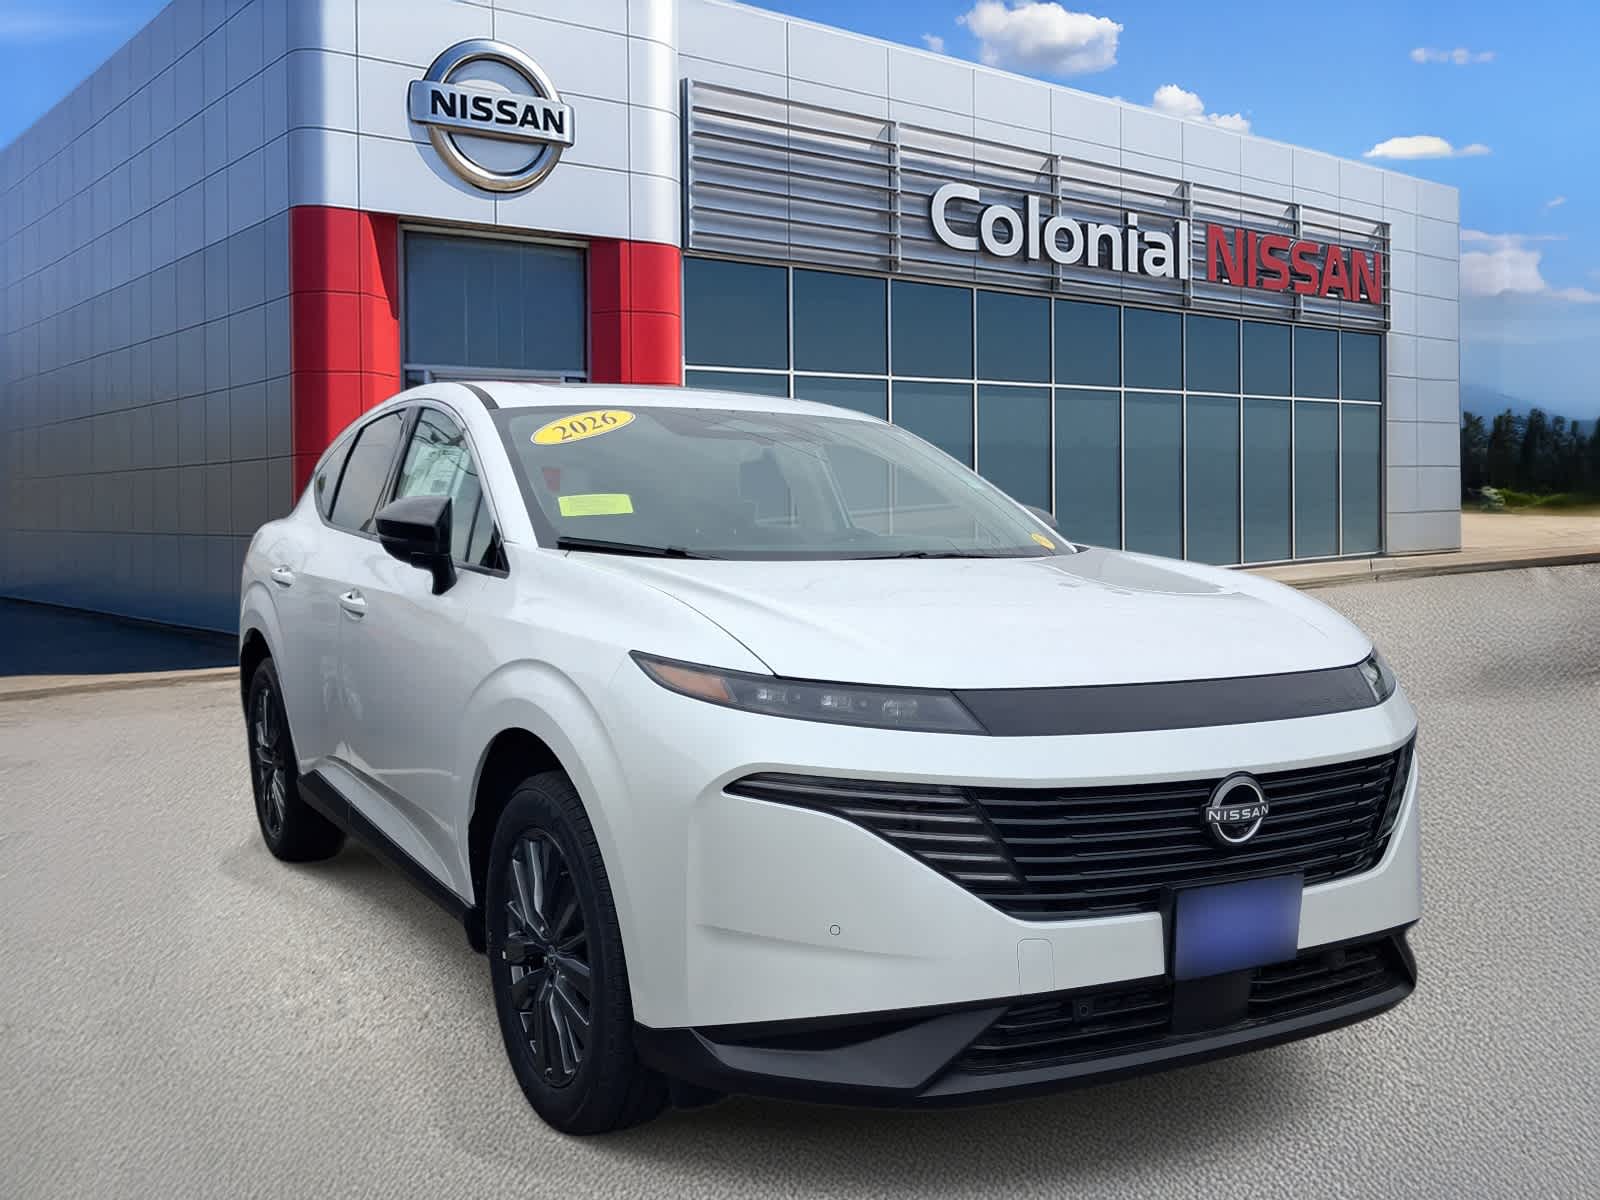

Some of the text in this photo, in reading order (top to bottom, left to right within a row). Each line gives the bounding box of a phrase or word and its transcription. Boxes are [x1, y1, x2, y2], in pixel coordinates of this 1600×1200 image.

[430, 89, 565, 135] NISSAN
[930, 182, 1383, 304] Colonial NISSAN
[552, 412, 618, 440] 2026
[1208, 803, 1270, 821] NISSAN
